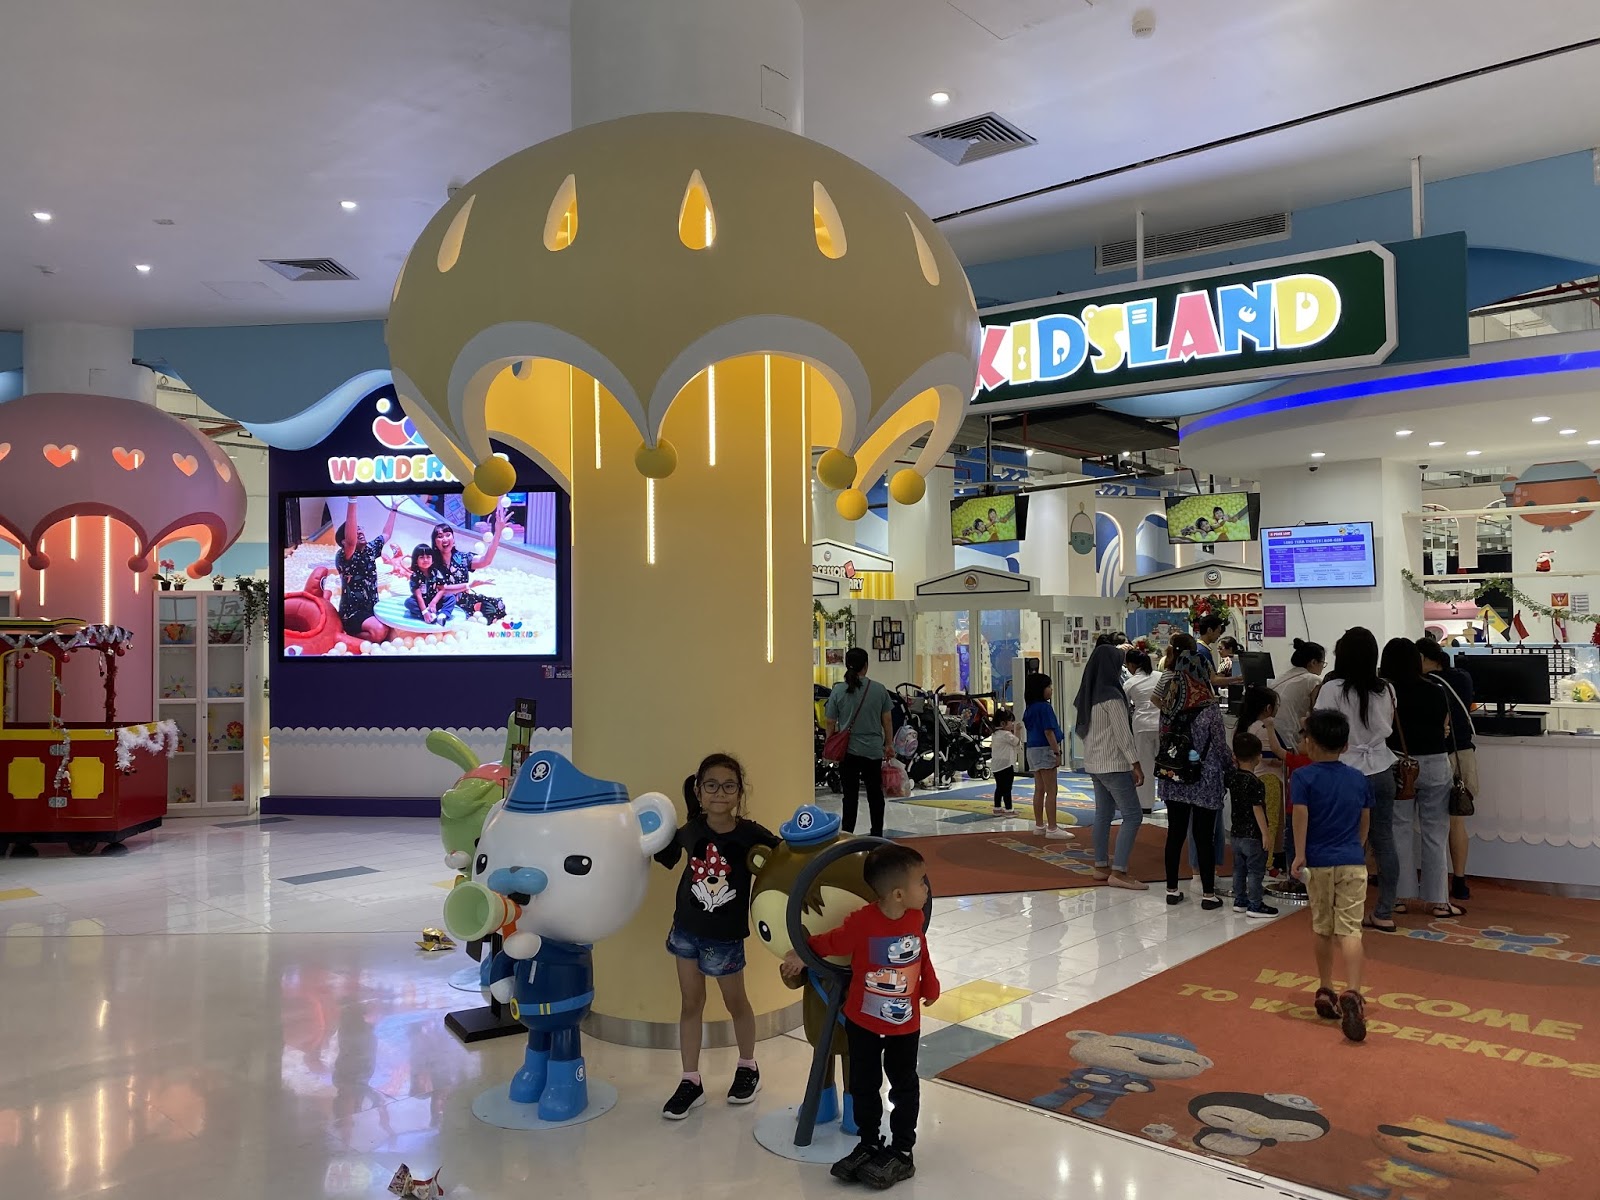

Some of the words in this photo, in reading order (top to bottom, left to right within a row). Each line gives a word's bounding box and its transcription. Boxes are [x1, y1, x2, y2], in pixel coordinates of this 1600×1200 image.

[328, 453, 509, 484] WONDER
[1144, 593, 1200, 608] MERRY
[1210, 592, 1262, 608] HRIS
[1376, 927, 1600, 966] NDERKID
[1177, 983, 1239, 1002] TO
[1249, 997, 1600, 1079] WODERKIDS
